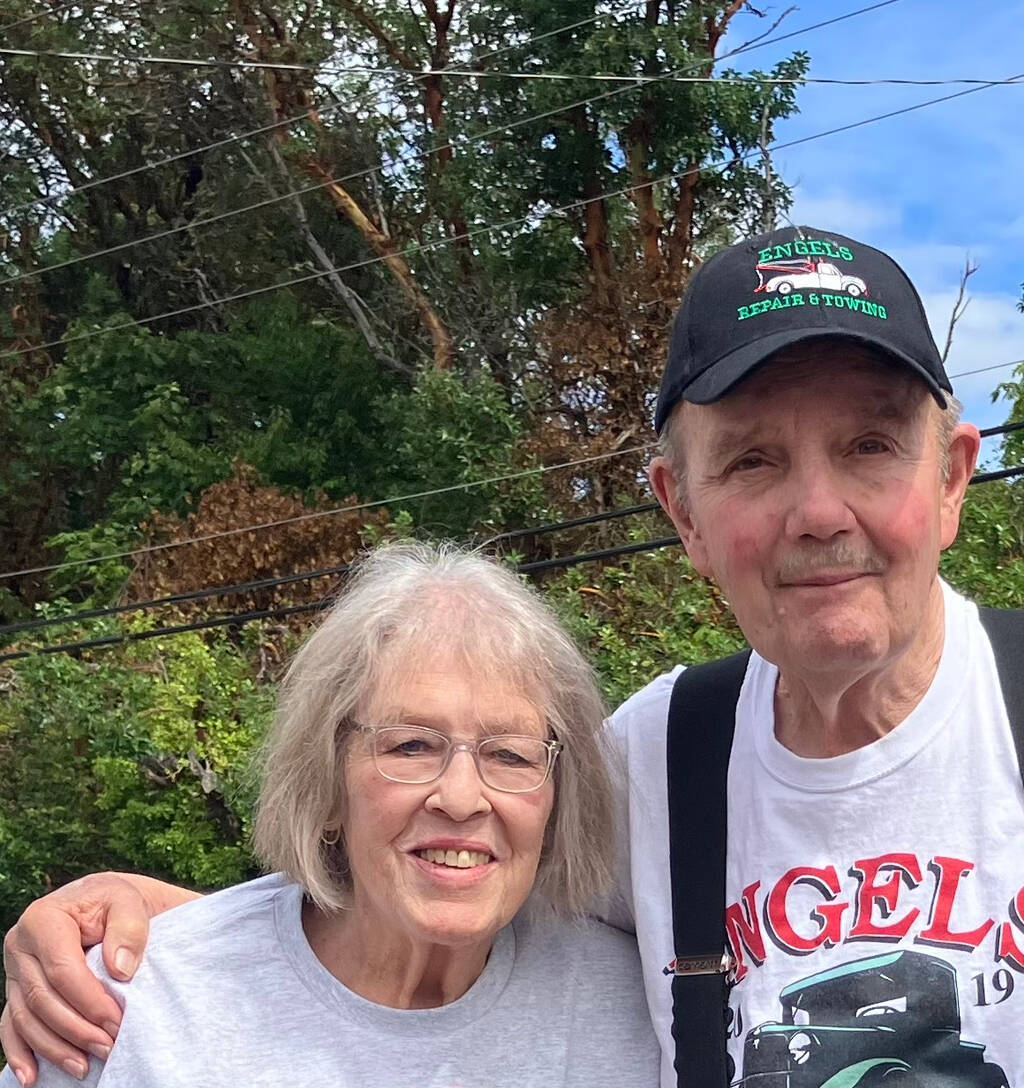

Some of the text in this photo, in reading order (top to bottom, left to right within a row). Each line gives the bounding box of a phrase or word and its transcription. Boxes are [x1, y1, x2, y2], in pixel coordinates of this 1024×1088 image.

[758, 240, 854, 263] ENGELS
[737, 294, 887, 321] REPAIR & TOWING
[970, 968, 1015, 1007] 19
